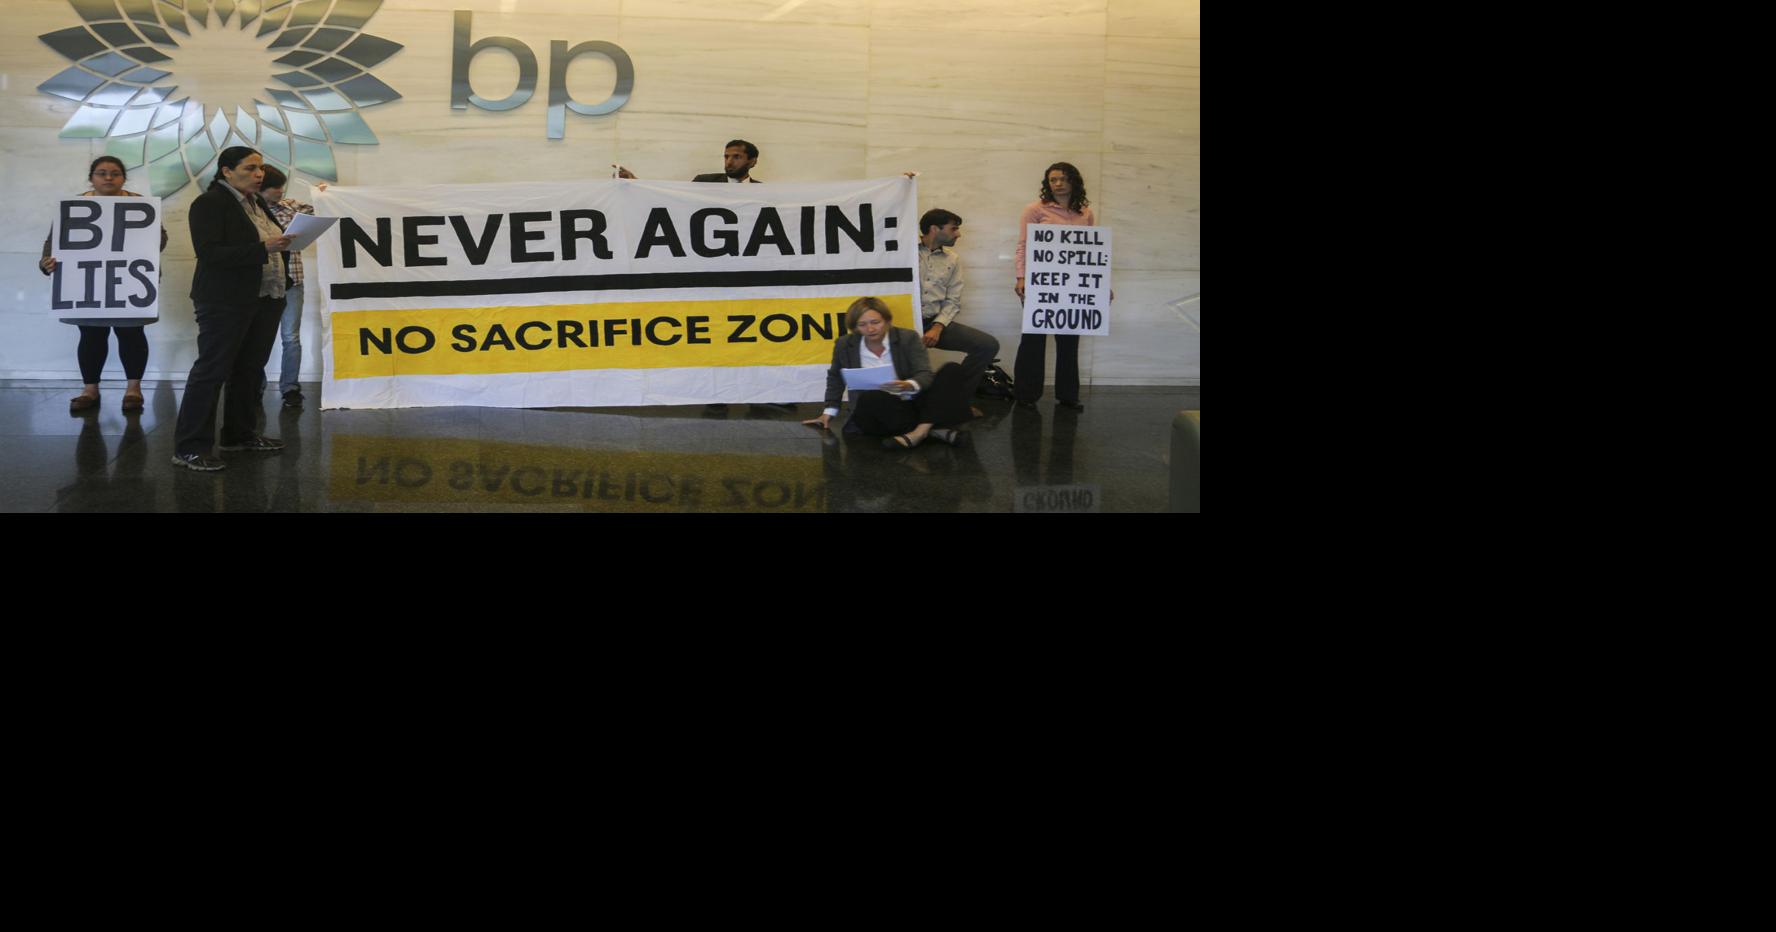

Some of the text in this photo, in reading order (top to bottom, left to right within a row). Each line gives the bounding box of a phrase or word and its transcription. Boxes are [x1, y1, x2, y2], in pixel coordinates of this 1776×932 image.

[451, 10, 635, 140] bp
[59, 199, 157, 252] BP
[339, 202, 899, 269] NEVER AGAIN:
[1034, 230, 1104, 246] NO KILL
[1033, 249, 1108, 266] NO SPILL:
[52, 258, 158, 311] LIES
[1031, 272, 1103, 288] KEEP IT
[1038, 292, 1096, 306] IN THE
[359, 325, 436, 356] NO
[451, 314, 712, 353] SACRIFICE
[1032, 308, 1102, 330] GROUND
